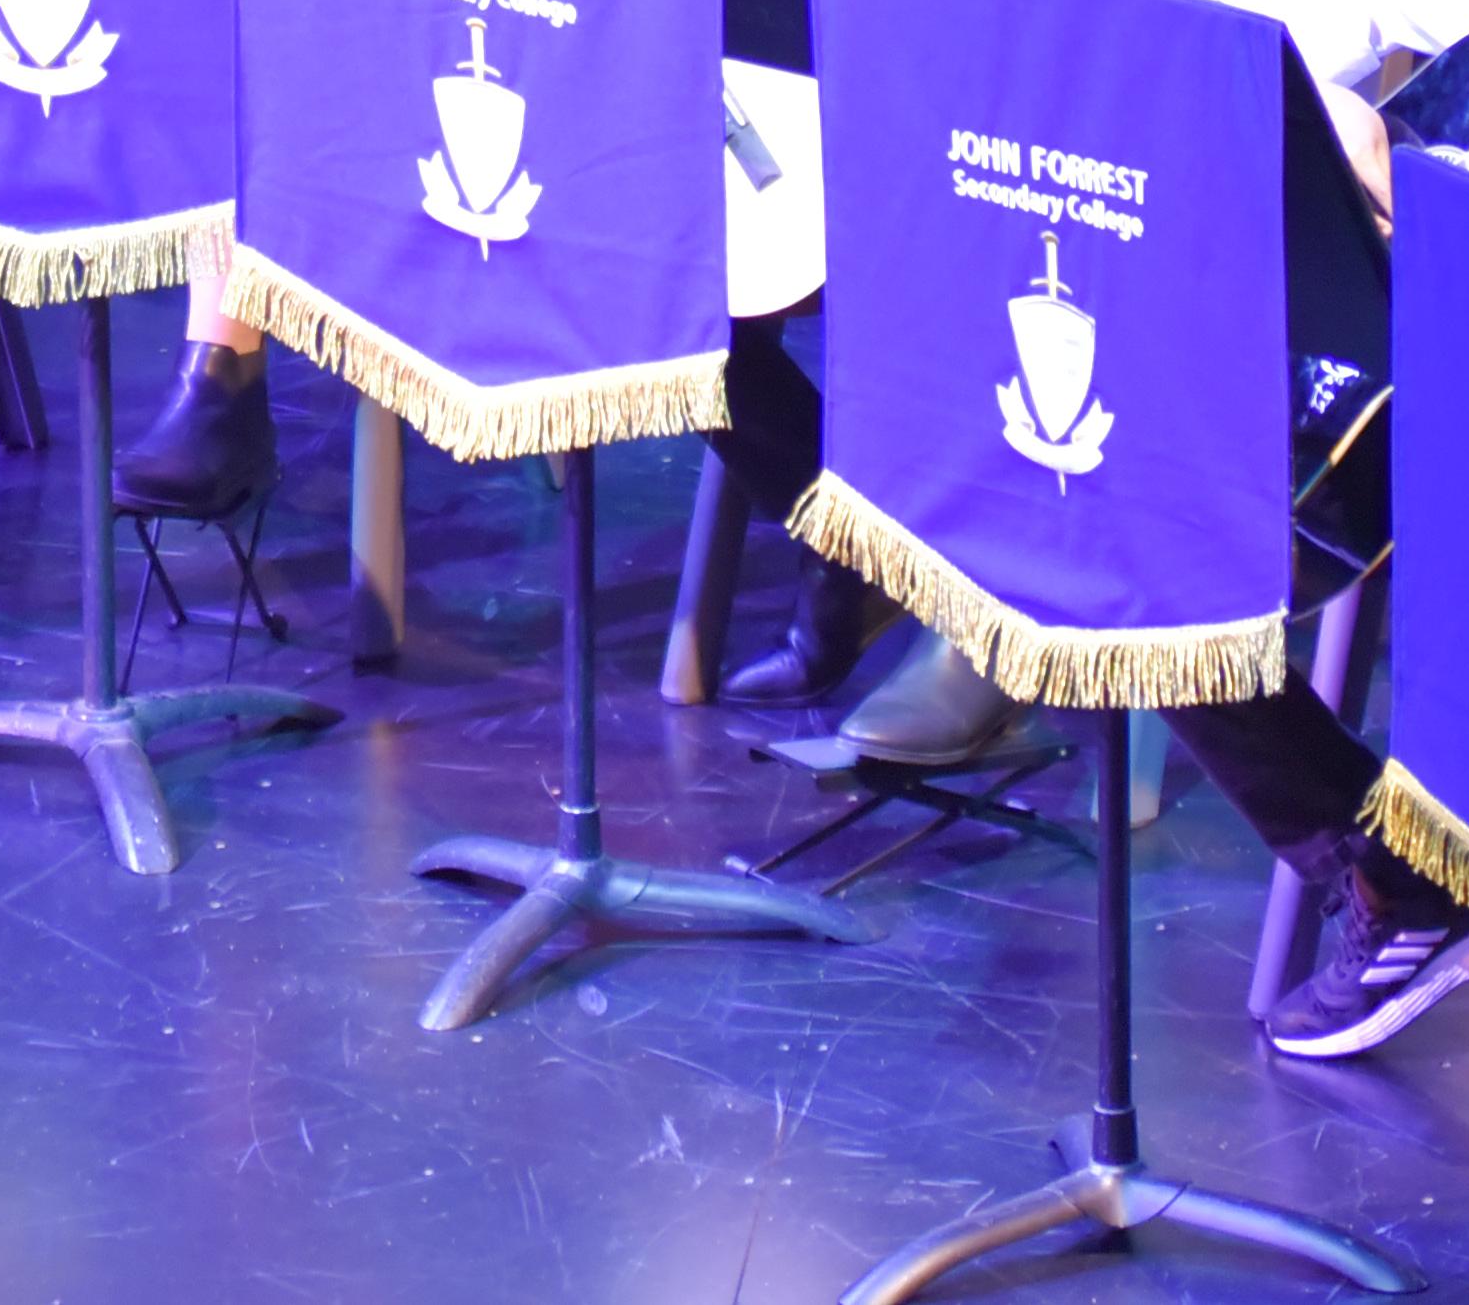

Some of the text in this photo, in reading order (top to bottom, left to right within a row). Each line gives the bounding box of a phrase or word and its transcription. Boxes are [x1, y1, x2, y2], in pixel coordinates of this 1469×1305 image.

[947, 129, 1149, 205] JOHN FORREST
[952, 168, 1144, 242] Secondary College
